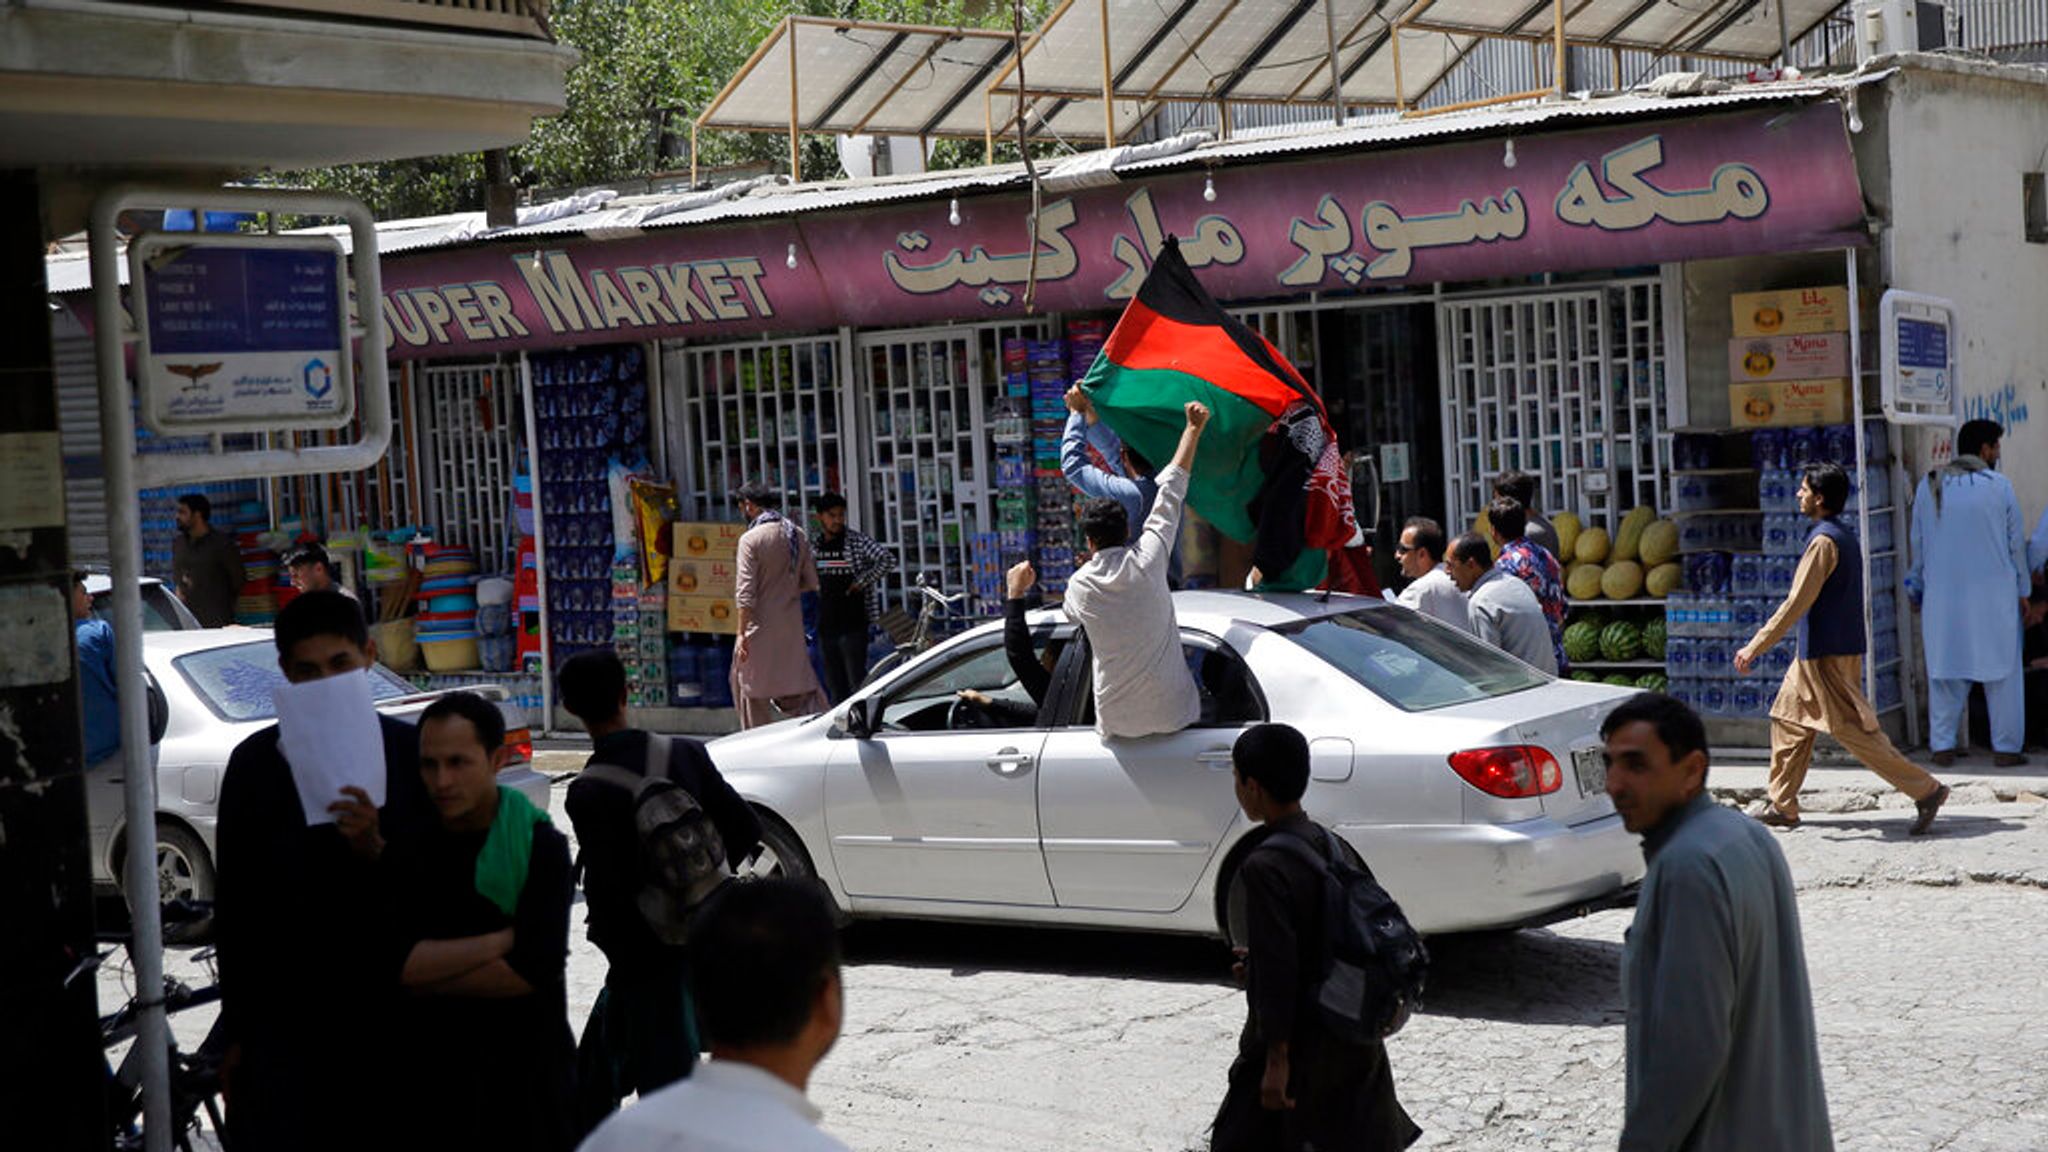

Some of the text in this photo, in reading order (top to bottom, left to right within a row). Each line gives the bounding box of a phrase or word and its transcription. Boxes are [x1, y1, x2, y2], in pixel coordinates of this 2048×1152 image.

[1556, 134, 1770, 232] مکه
[1278, 187, 1528, 286] سوپر
[511, 249, 777, 334] MARKET
